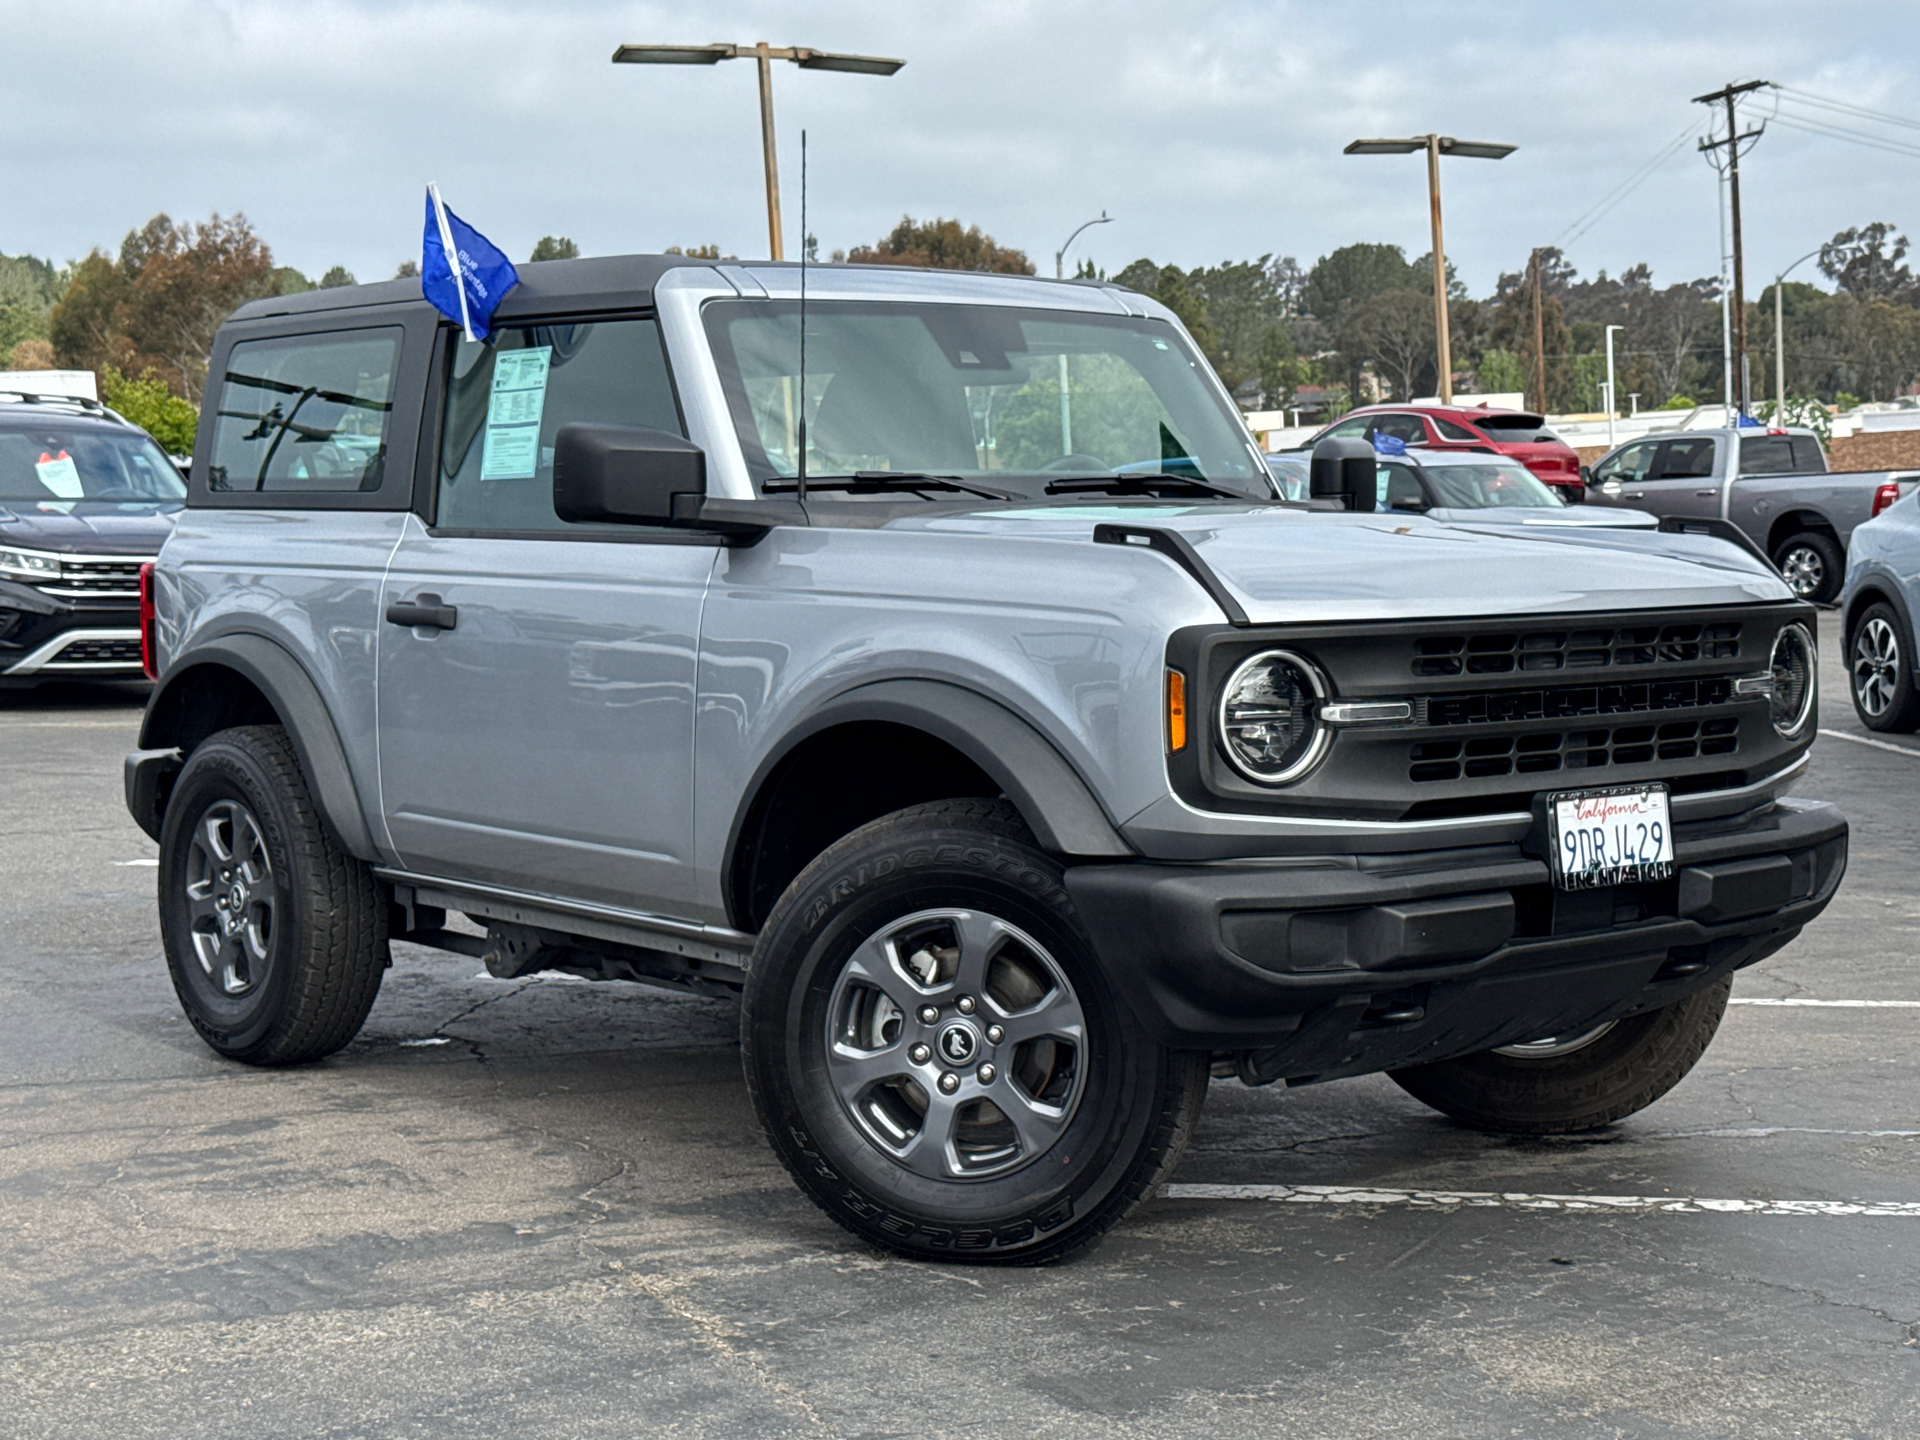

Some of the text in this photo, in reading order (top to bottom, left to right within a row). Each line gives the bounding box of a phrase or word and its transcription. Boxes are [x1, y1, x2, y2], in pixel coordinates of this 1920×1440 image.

[457, 249, 479, 270] Blue
[460, 264, 488, 299] dvantage
[1577, 798, 1648, 824] California
[1564, 821, 1663, 873] 9DRJ429
[803, 844, 1078, 931] BRIDGESTON
